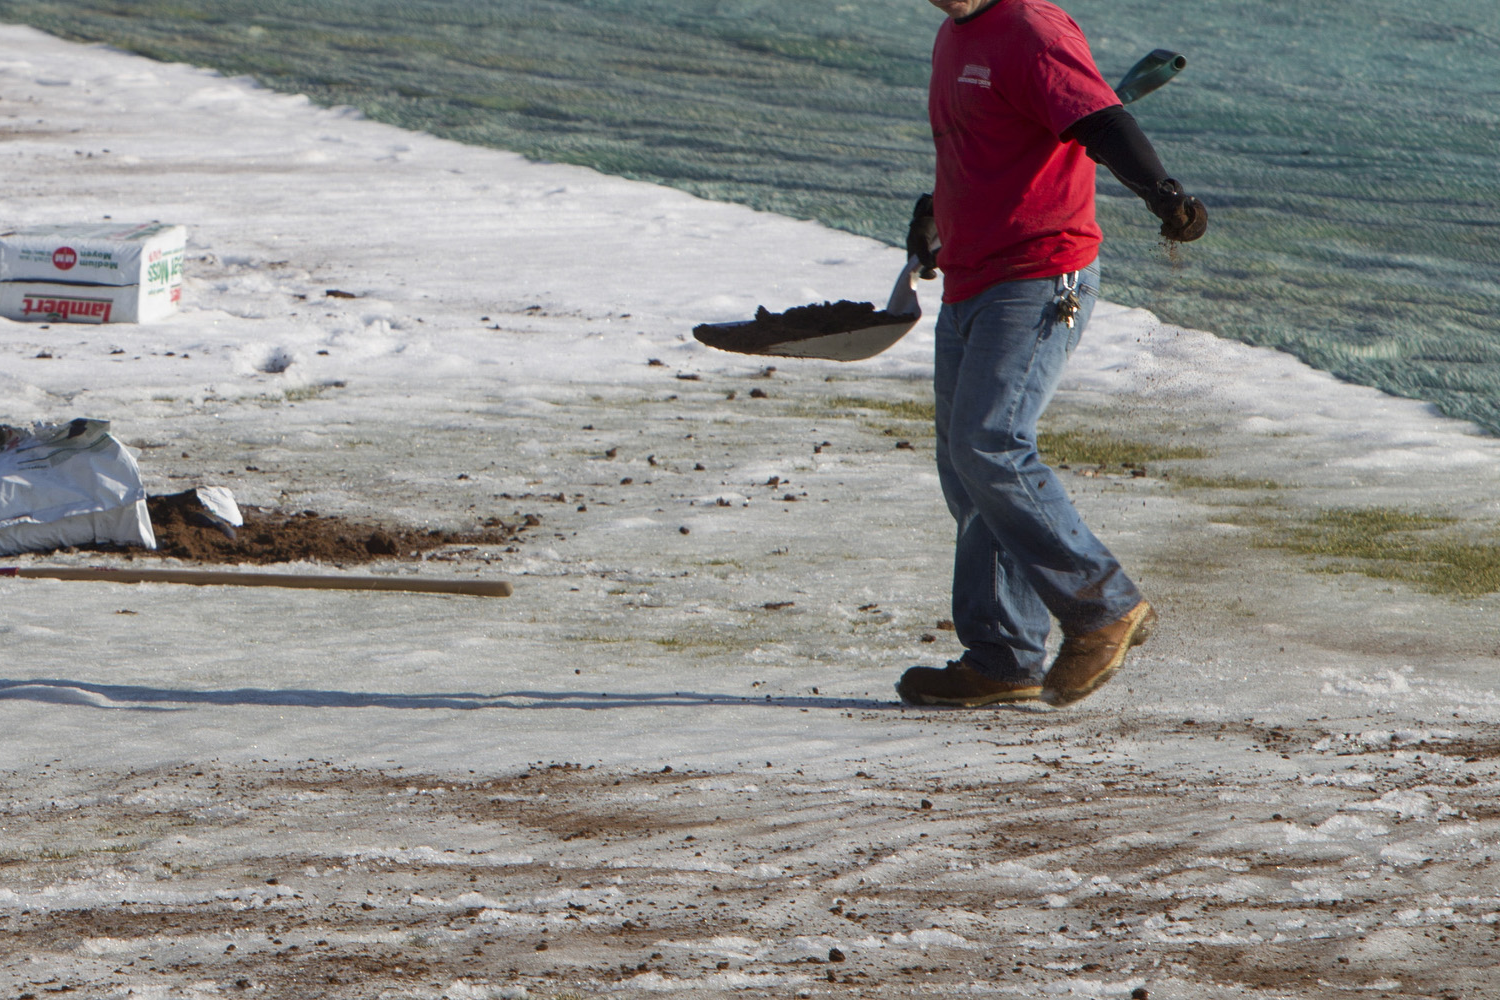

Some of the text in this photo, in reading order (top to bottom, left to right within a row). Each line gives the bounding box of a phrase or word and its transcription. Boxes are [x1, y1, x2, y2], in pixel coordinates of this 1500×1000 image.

[80, 250, 112, 260] Moyen
[79, 259, 118, 270] Medium
[22, 298, 113, 322] lambert
